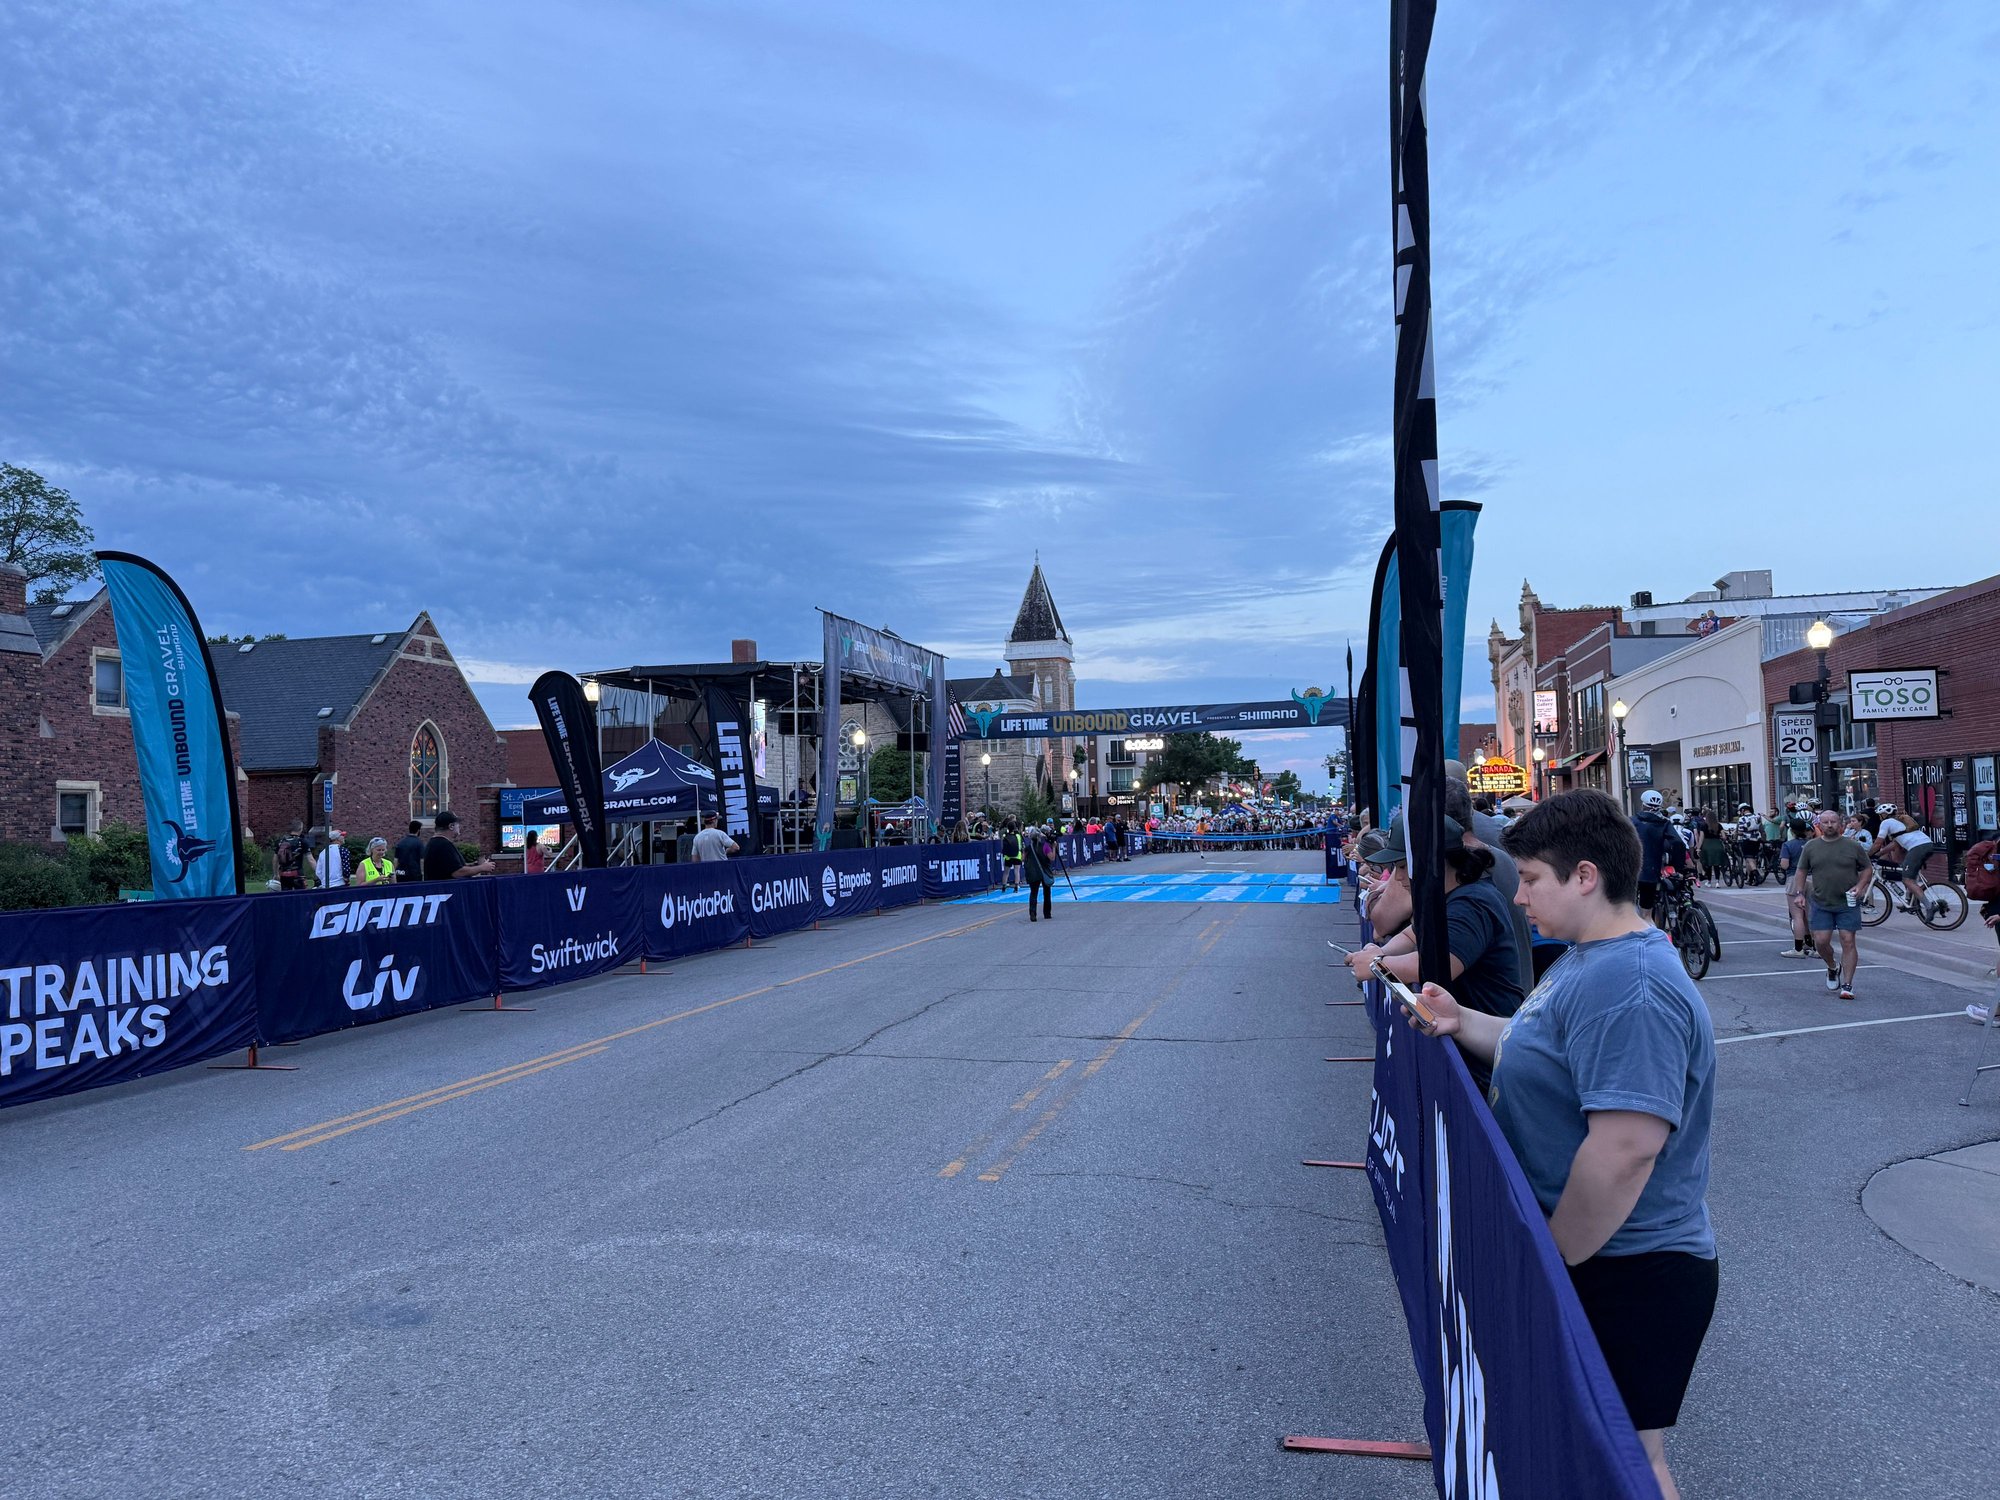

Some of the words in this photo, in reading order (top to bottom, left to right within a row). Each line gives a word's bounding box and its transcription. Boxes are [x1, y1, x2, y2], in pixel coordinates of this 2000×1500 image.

[157, 623, 180, 696] GRAVEL
[170, 623, 186, 670] SHIMANO
[1858, 686, 1931, 706] TOSO
[168, 698, 191, 776] UNBOUND
[1053, 713, 1128, 734] UNBOUND
[1130, 711, 1203, 728] GRAVEL
[1239, 709, 1299, 721] SHIMANO
[1781, 718, 1812, 727] SPEED
[1785, 728, 1809, 736] LIMIT
[1781, 736, 1815, 754] 20
[1791, 758, 1796, 766] 2
[1906, 765, 1943, 785] EMPORIA
[1953, 761, 1964, 770] 827
[1978, 765, 1993, 785] LOVE
[577, 797, 594, 832] PRIX
[881, 864, 918, 888] SHIMANO
[677, 888, 735, 926] HydraPak
[751, 875, 812, 914] GARMIN
[309, 893, 453, 940] GIANT
[531, 930, 619, 974] Swiftwick
[0, 944, 230, 1017] TRAINING
[342, 954, 421, 1010] Liv
[0, 1004, 171, 1077] PEAKS
